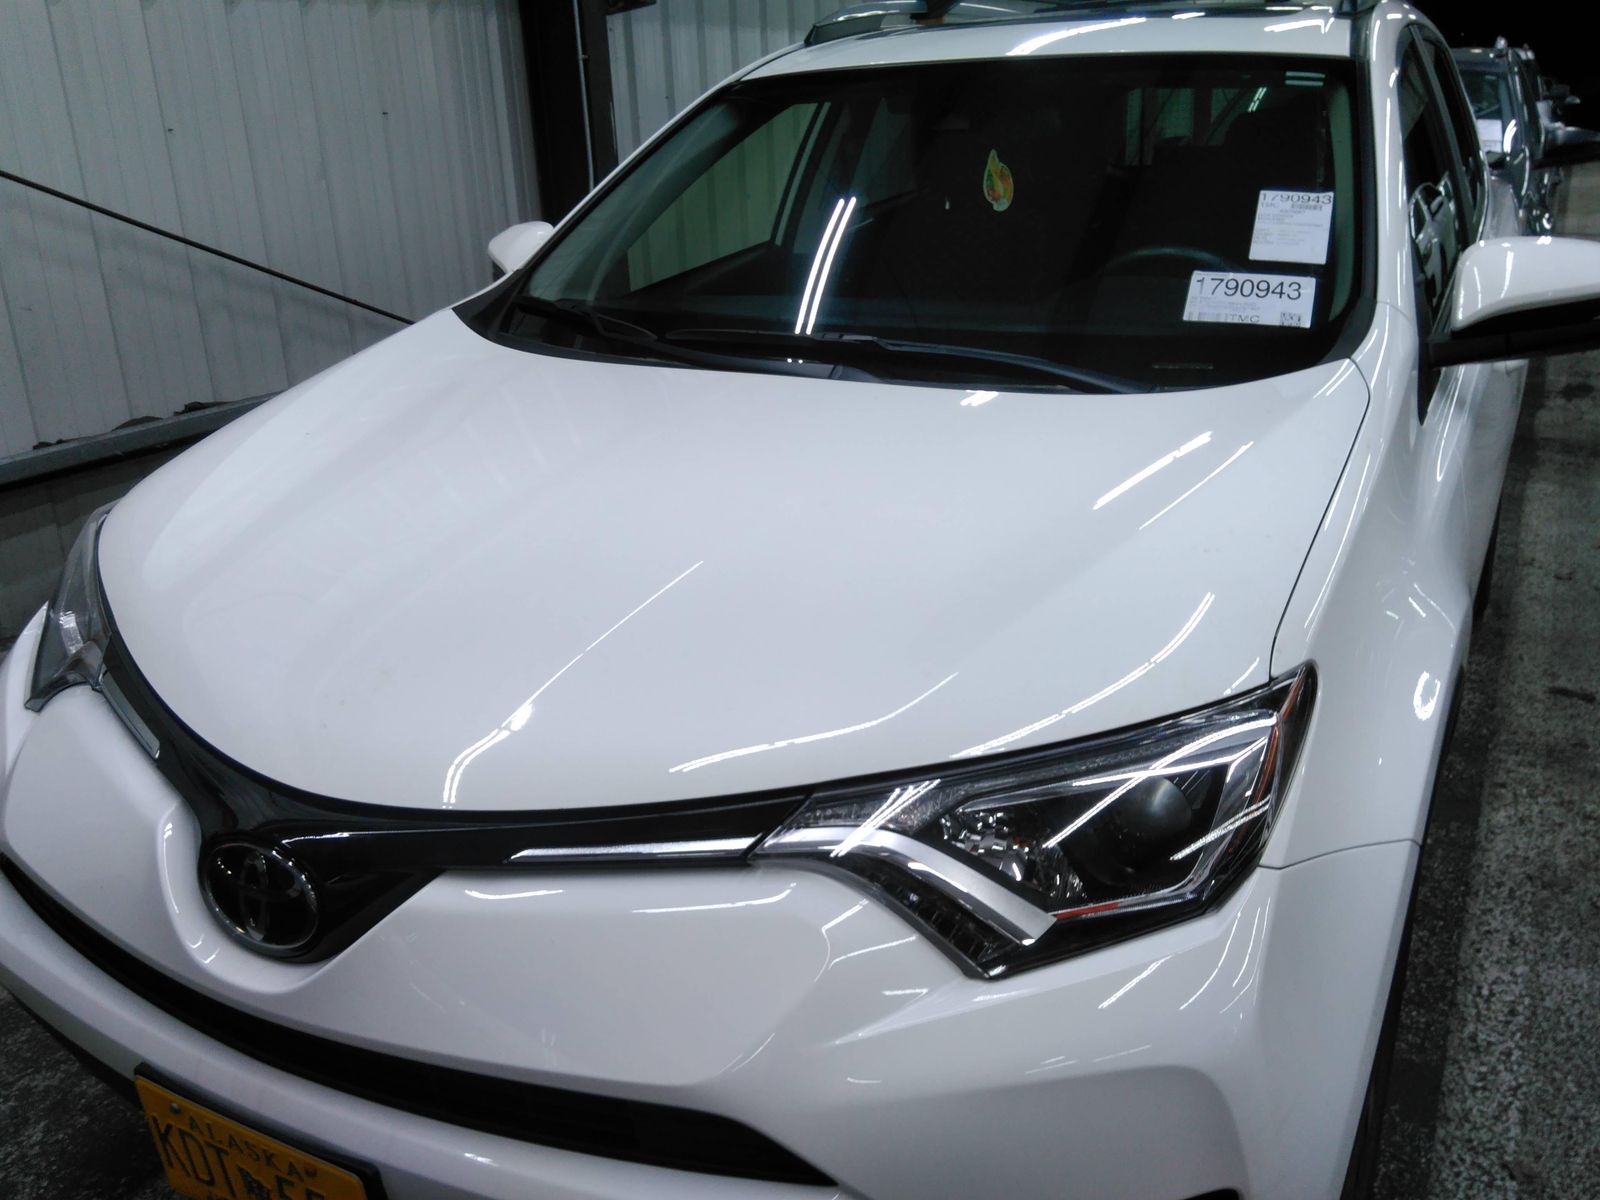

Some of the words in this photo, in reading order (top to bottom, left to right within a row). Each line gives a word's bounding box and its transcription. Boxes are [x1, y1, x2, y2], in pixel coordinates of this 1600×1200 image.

[1262, 193, 1332, 205] 1790943
[1196, 277, 1302, 301] 1790943
[1229, 314, 1261, 324] TMC
[152, 1115, 237, 1199] KDT
[189, 1116, 304, 1181] ALASKA
